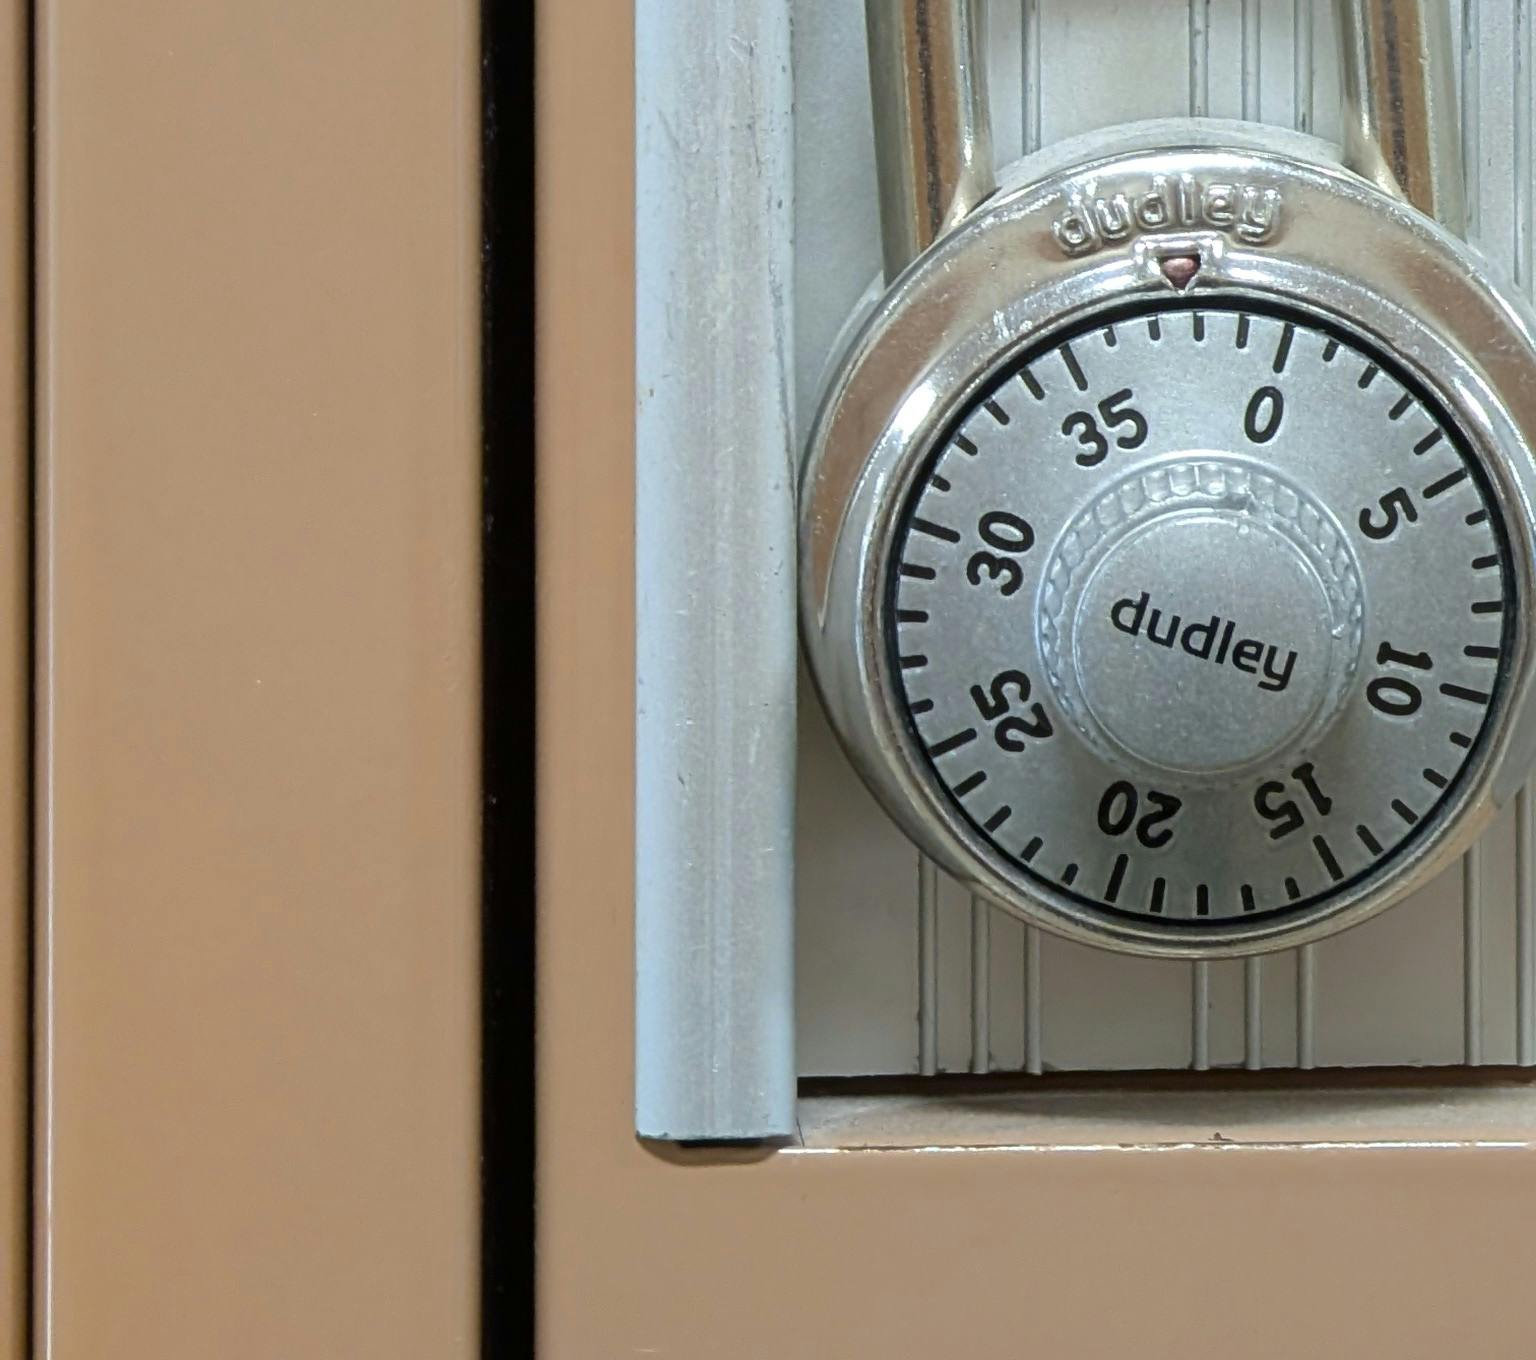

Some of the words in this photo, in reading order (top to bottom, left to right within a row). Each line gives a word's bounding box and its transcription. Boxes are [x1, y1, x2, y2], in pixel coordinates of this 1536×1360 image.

[1052, 172, 1282, 256] dudley
[1062, 389, 1147, 466] 35
[1245, 387, 1283, 443] 0
[1359, 487, 1417, 539] 5
[967, 511, 1034, 596] 30
[1111, 592, 1297, 692] dudley
[1366, 641, 1433, 716] 10
[970, 670, 1054, 752] 25
[1097, 780, 1182, 848] 20
[1254, 762, 1332, 840] 15
